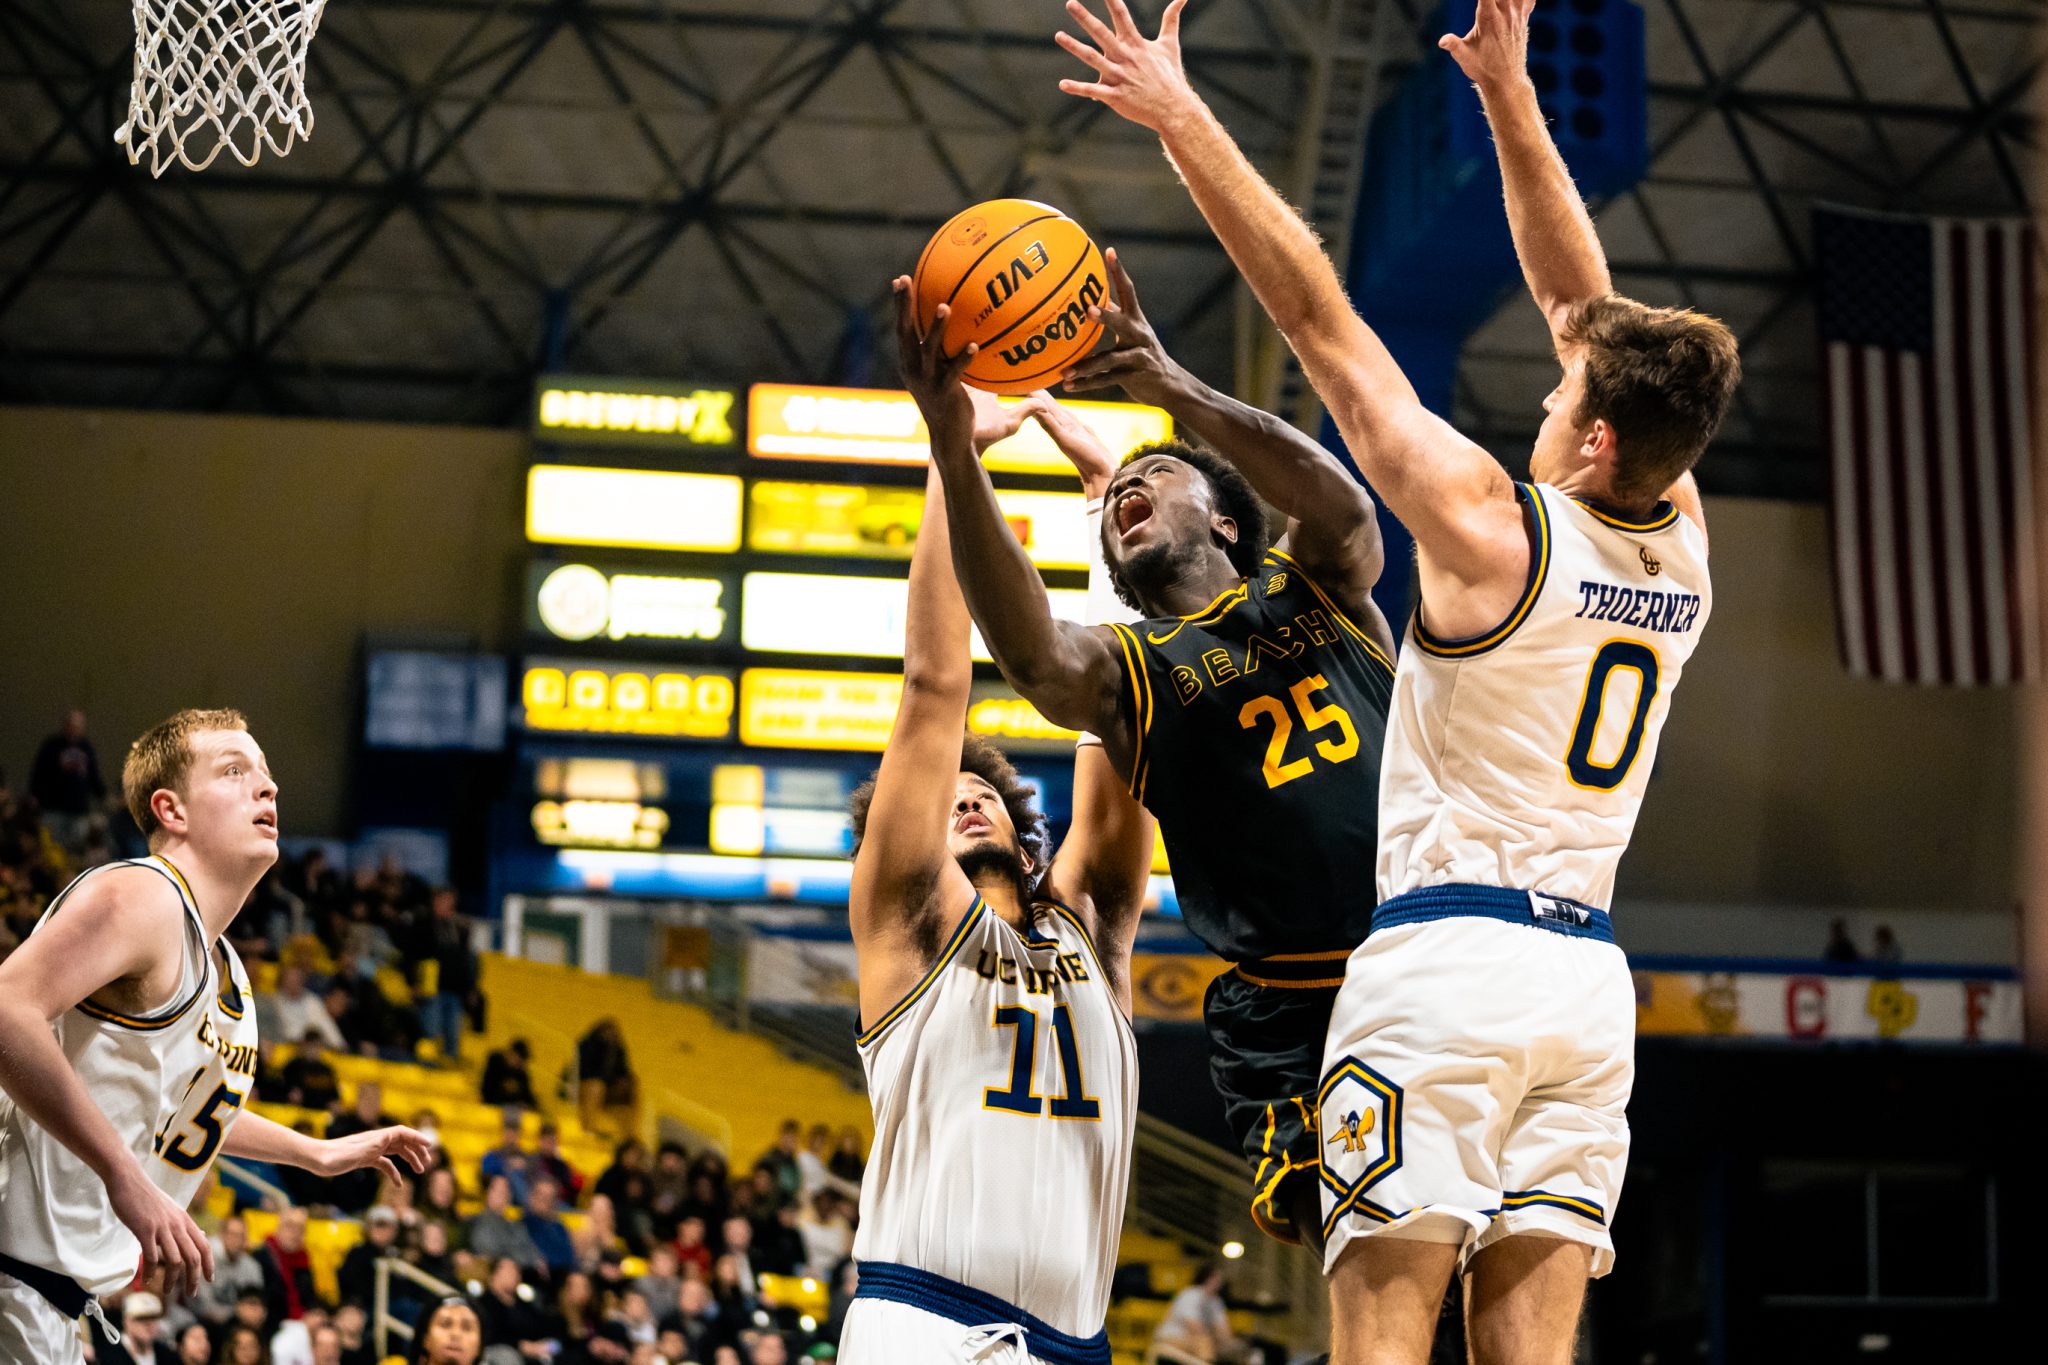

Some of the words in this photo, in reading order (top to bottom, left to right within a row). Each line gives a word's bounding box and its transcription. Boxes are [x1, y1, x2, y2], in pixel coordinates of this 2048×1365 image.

[999, 272, 1104, 367] Wilson
[1575, 580, 1700, 633] THOERNER
[1238, 674, 1359, 789] 25
[1564, 637, 1661, 793] 0
[982, 1002, 1102, 1122] 11
